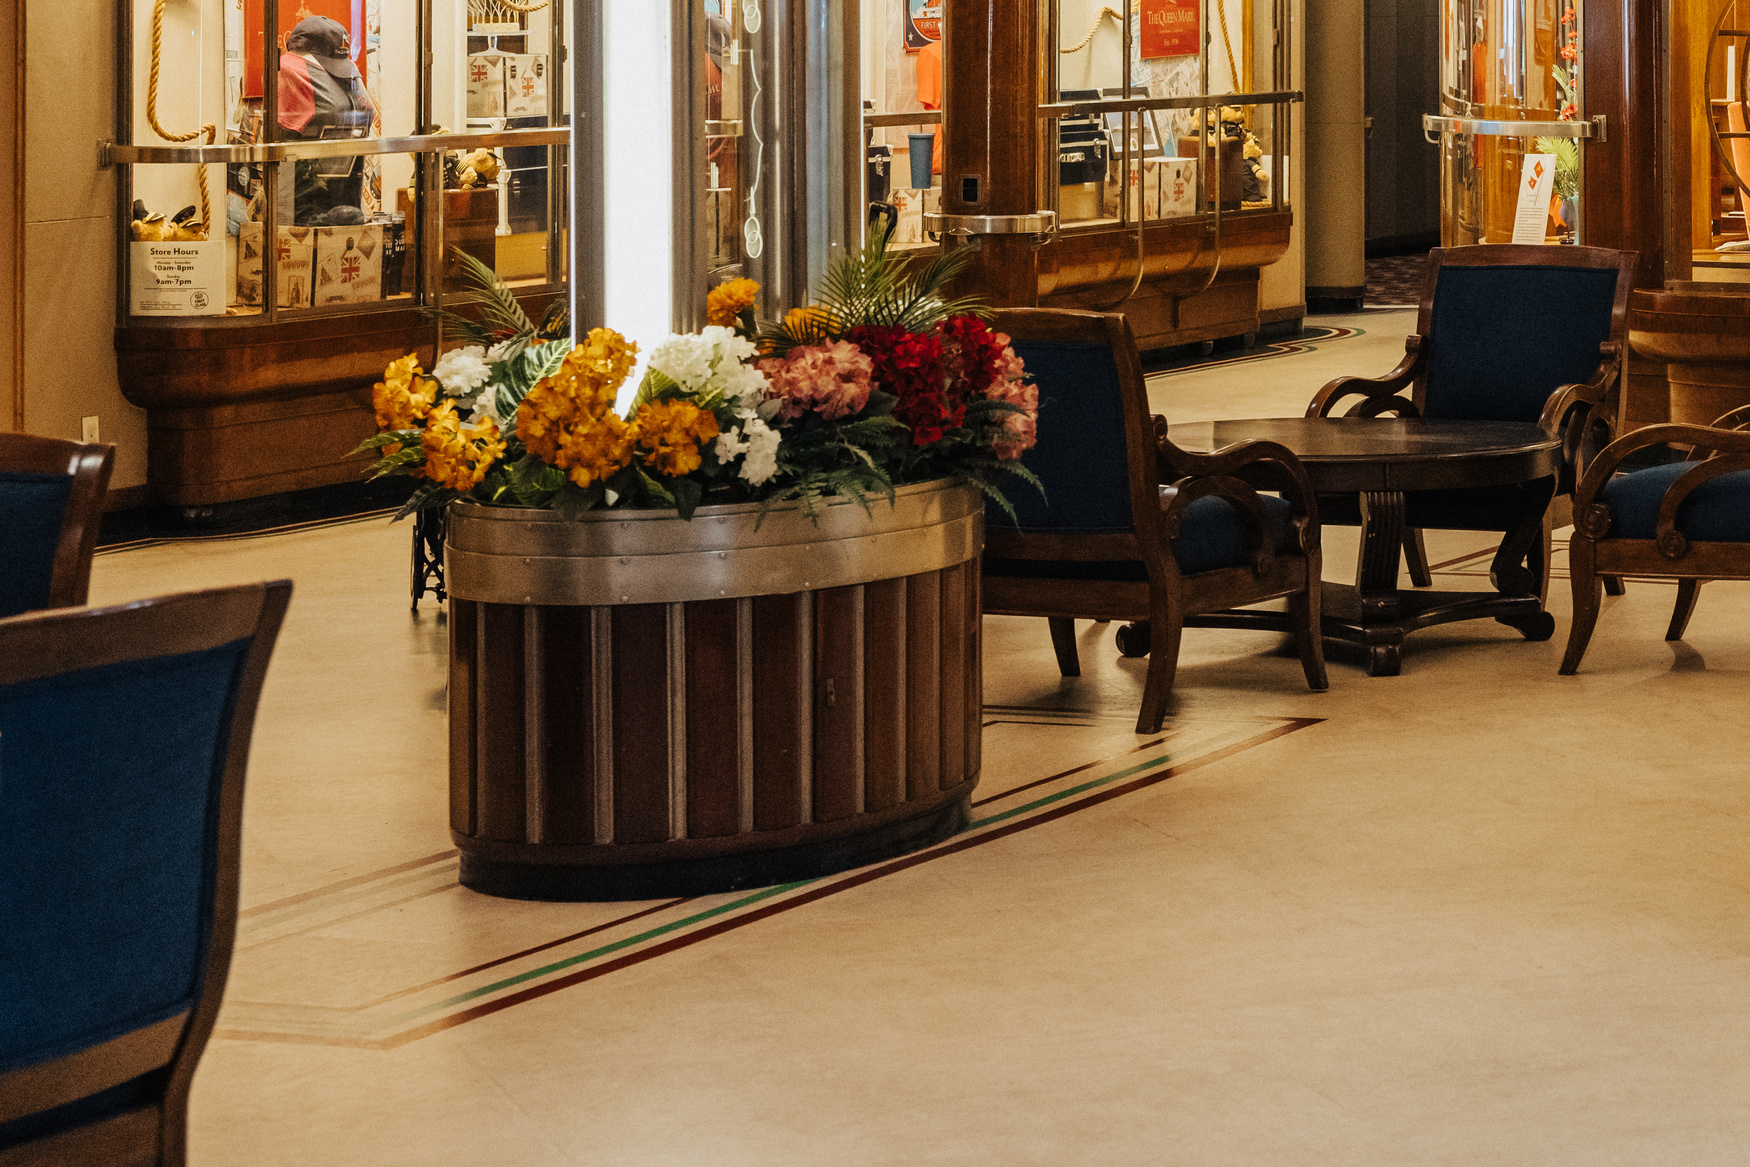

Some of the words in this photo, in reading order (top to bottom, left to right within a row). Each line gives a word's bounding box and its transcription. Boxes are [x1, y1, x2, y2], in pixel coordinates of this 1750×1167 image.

[1147, 11, 1159, 25] THE
[1158, 10, 1178, 27] QUEEN
[921, 21, 936, 29] FIRST
[150, 247, 171, 255] Store
[173, 247, 199, 255] Hours
[156, 278, 192, 286] 9am-7pm
